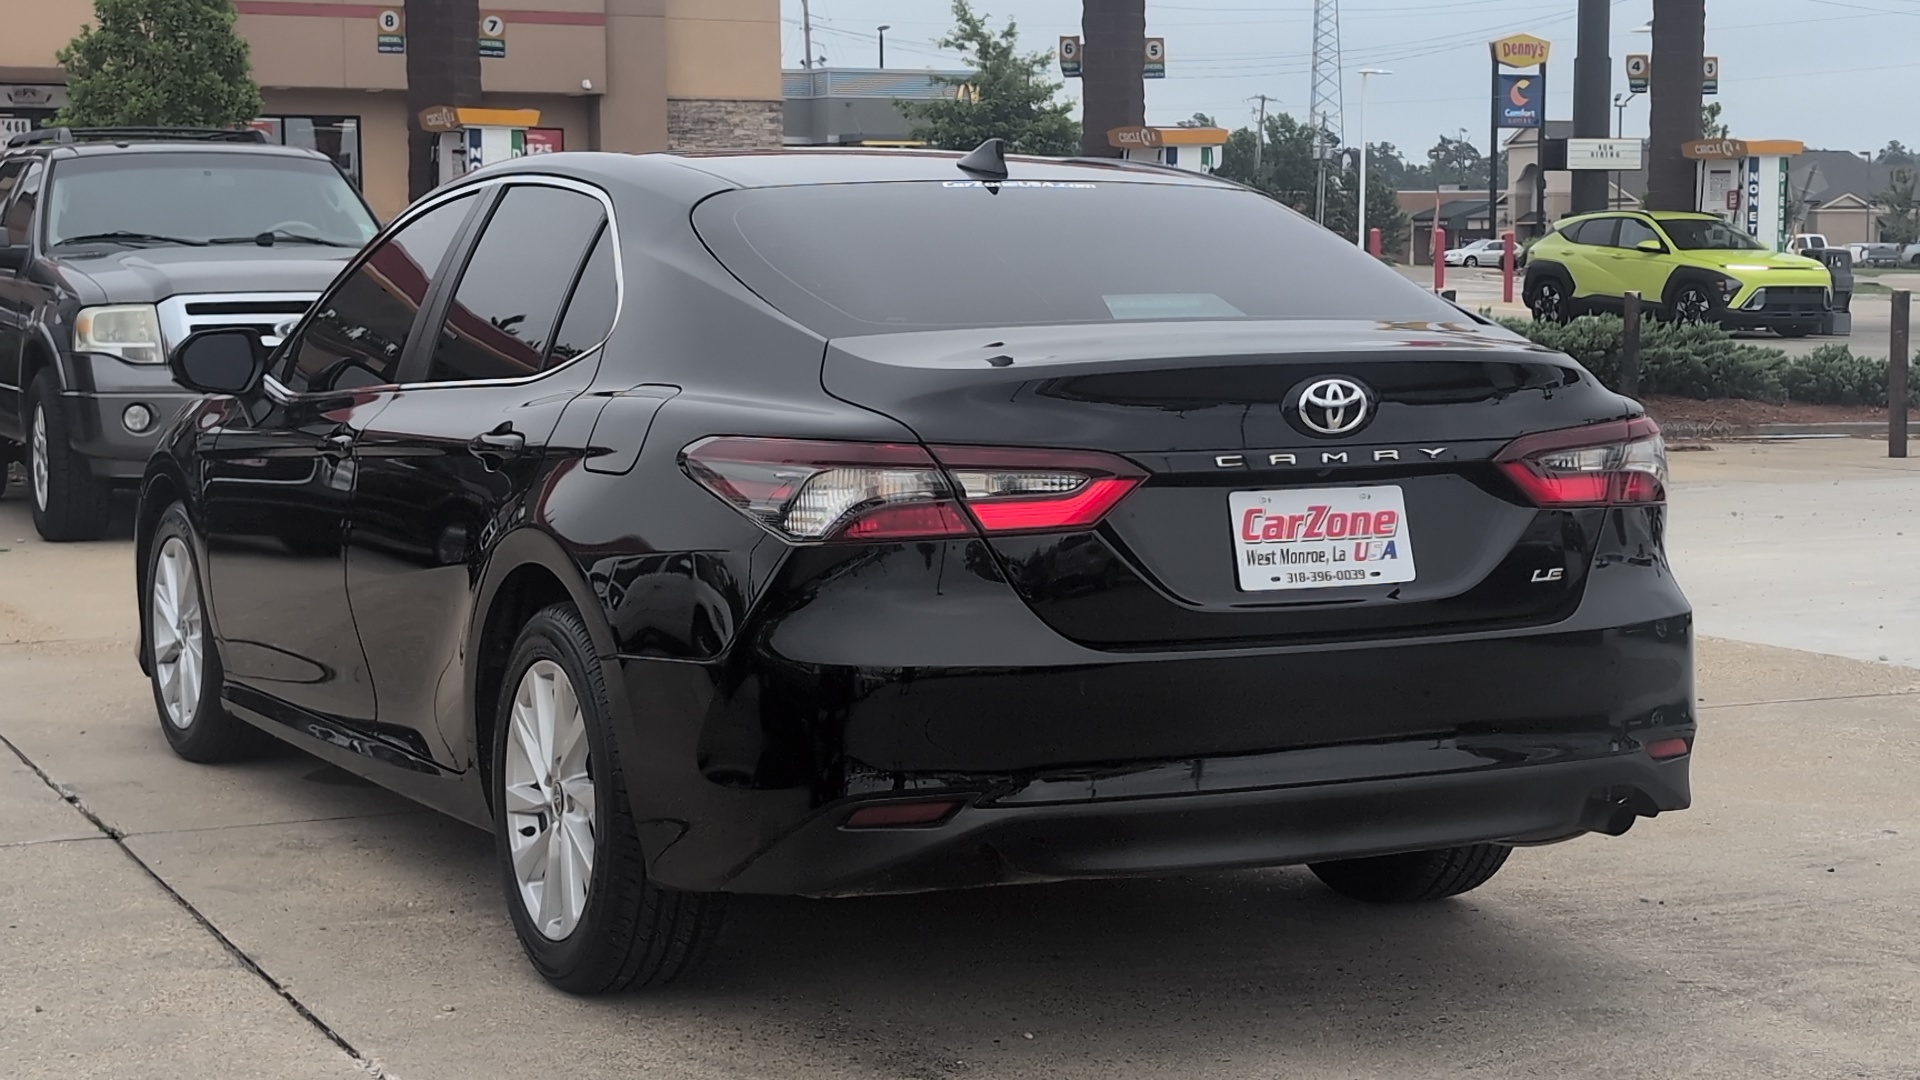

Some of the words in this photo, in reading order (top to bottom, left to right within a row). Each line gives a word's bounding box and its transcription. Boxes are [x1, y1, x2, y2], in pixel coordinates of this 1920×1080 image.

[385, 14, 394, 27] 8
[488, 20, 498, 32] 7
[1065, 43, 1073, 55] 6
[1150, 45, 1158, 56] 5
[1502, 42, 1546, 59] Denny's
[1631, 61, 1641, 72] 4
[1706, 63, 1713, 73] 3
[1504, 108, 1535, 118] Comfort
[1118, 131, 1141, 142] CIRCLE
[1695, 143, 1721, 154] CIRCLE
[1778, 171, 1786, 242] DIESEL
[1214, 447, 1448, 467] CAMRY
[1241, 505, 1398, 544] CarZone
[1246, 548, 1277, 566] West
[1280, 547, 1330, 566] Monroe,
[1332, 546, 1346, 562] La
[1354, 540, 1398, 562] USA
[1286, 569, 1366, 583] 318-396-0039
[1531, 567, 1564, 582] LE
